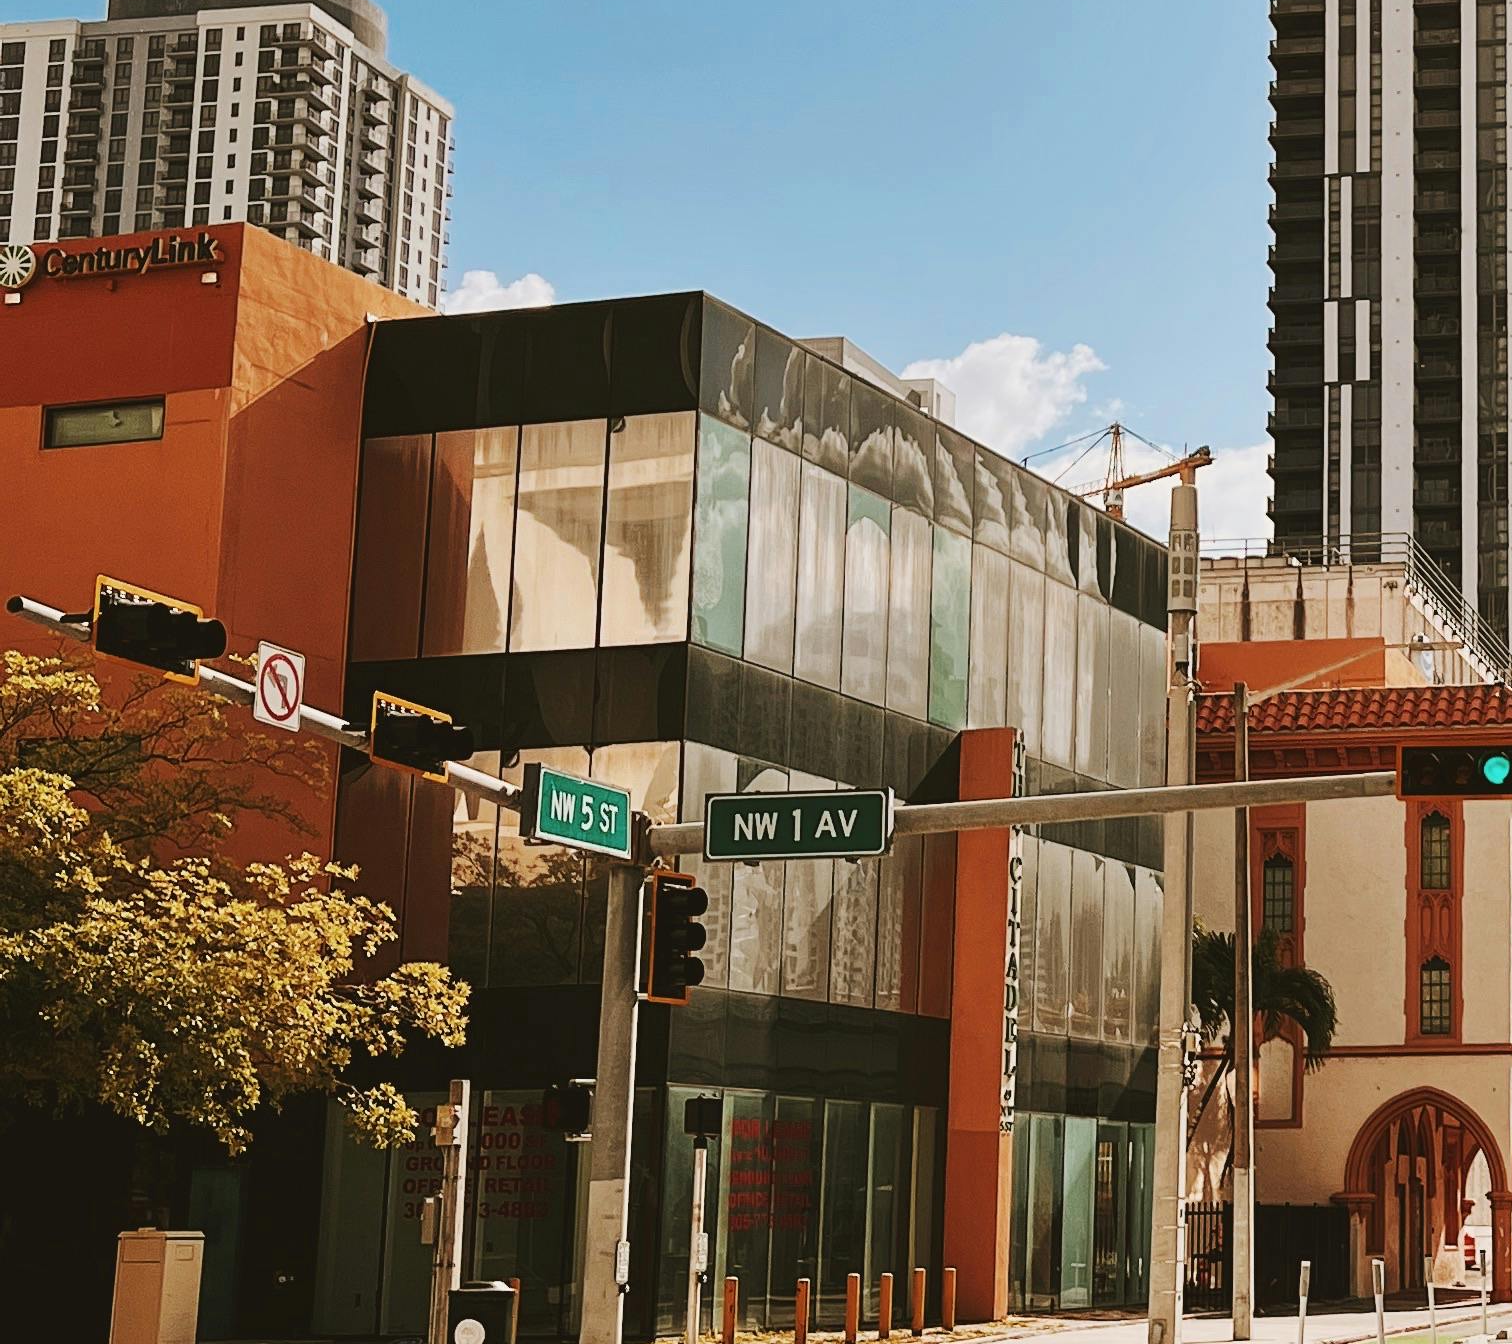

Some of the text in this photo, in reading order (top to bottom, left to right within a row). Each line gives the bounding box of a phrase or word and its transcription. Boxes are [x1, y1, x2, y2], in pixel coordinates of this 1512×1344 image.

[43, 232, 218, 277] CenturyLink
[550, 788, 619, 834] NW 5 ST
[734, 808, 858, 842] NW 1 AV
[1004, 856, 1023, 1079] CITADEL
[405, 1154, 557, 1171] GROD FLOOR
